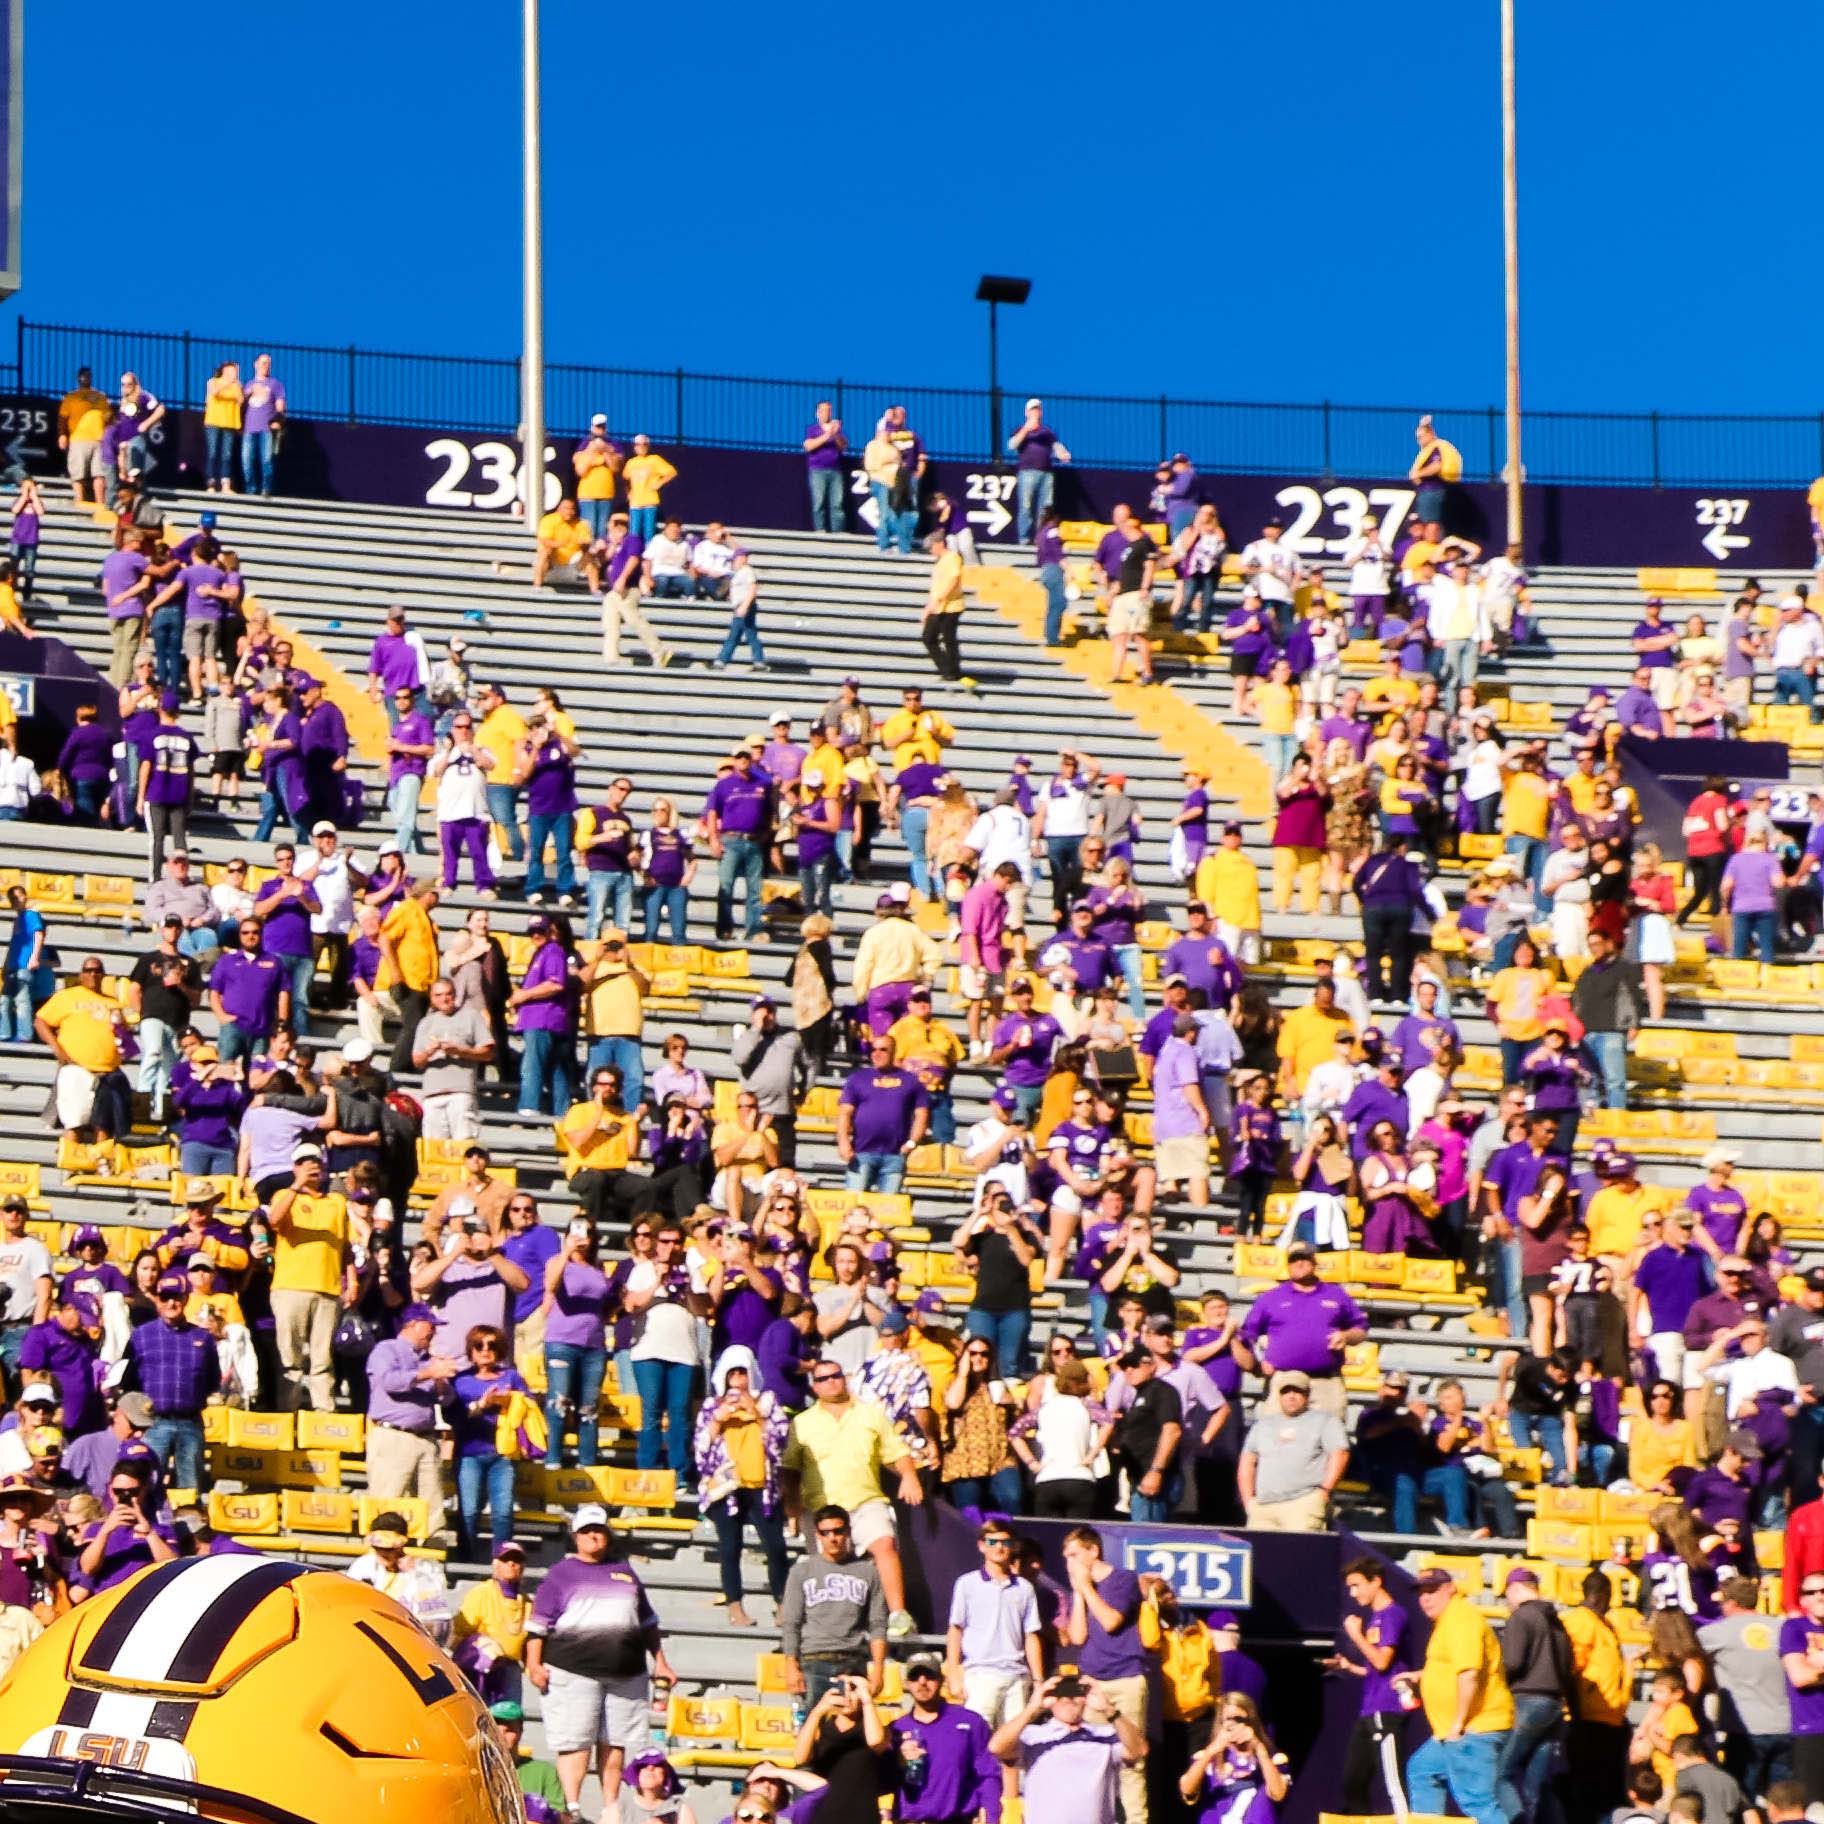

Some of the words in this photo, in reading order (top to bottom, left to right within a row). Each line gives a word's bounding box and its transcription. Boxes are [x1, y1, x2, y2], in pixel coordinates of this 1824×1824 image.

[0, 409, 48, 434] 235
[965, 475, 1017, 499] 237
[1276, 487, 1415, 553] 237
[1695, 499, 1749, 523] 237
[1014, 815, 1023, 838] 7
[243, 1425, 277, 1436] LSU
[312, 1426, 349, 1438] LSU
[557, 1480, 594, 1492] LSU
[623, 1480, 659, 1492] LSU
[223, 1504, 260, 1519] LSU
[301, 1503, 337, 1517] LSU
[1145, 1551, 1234, 1600] 215
[803, 1577, 867, 1606] LSU
[686, 1711, 721, 1725] LSU
[755, 1719, 792, 1732] LSU
[49, 1732, 149, 1766] LSU
